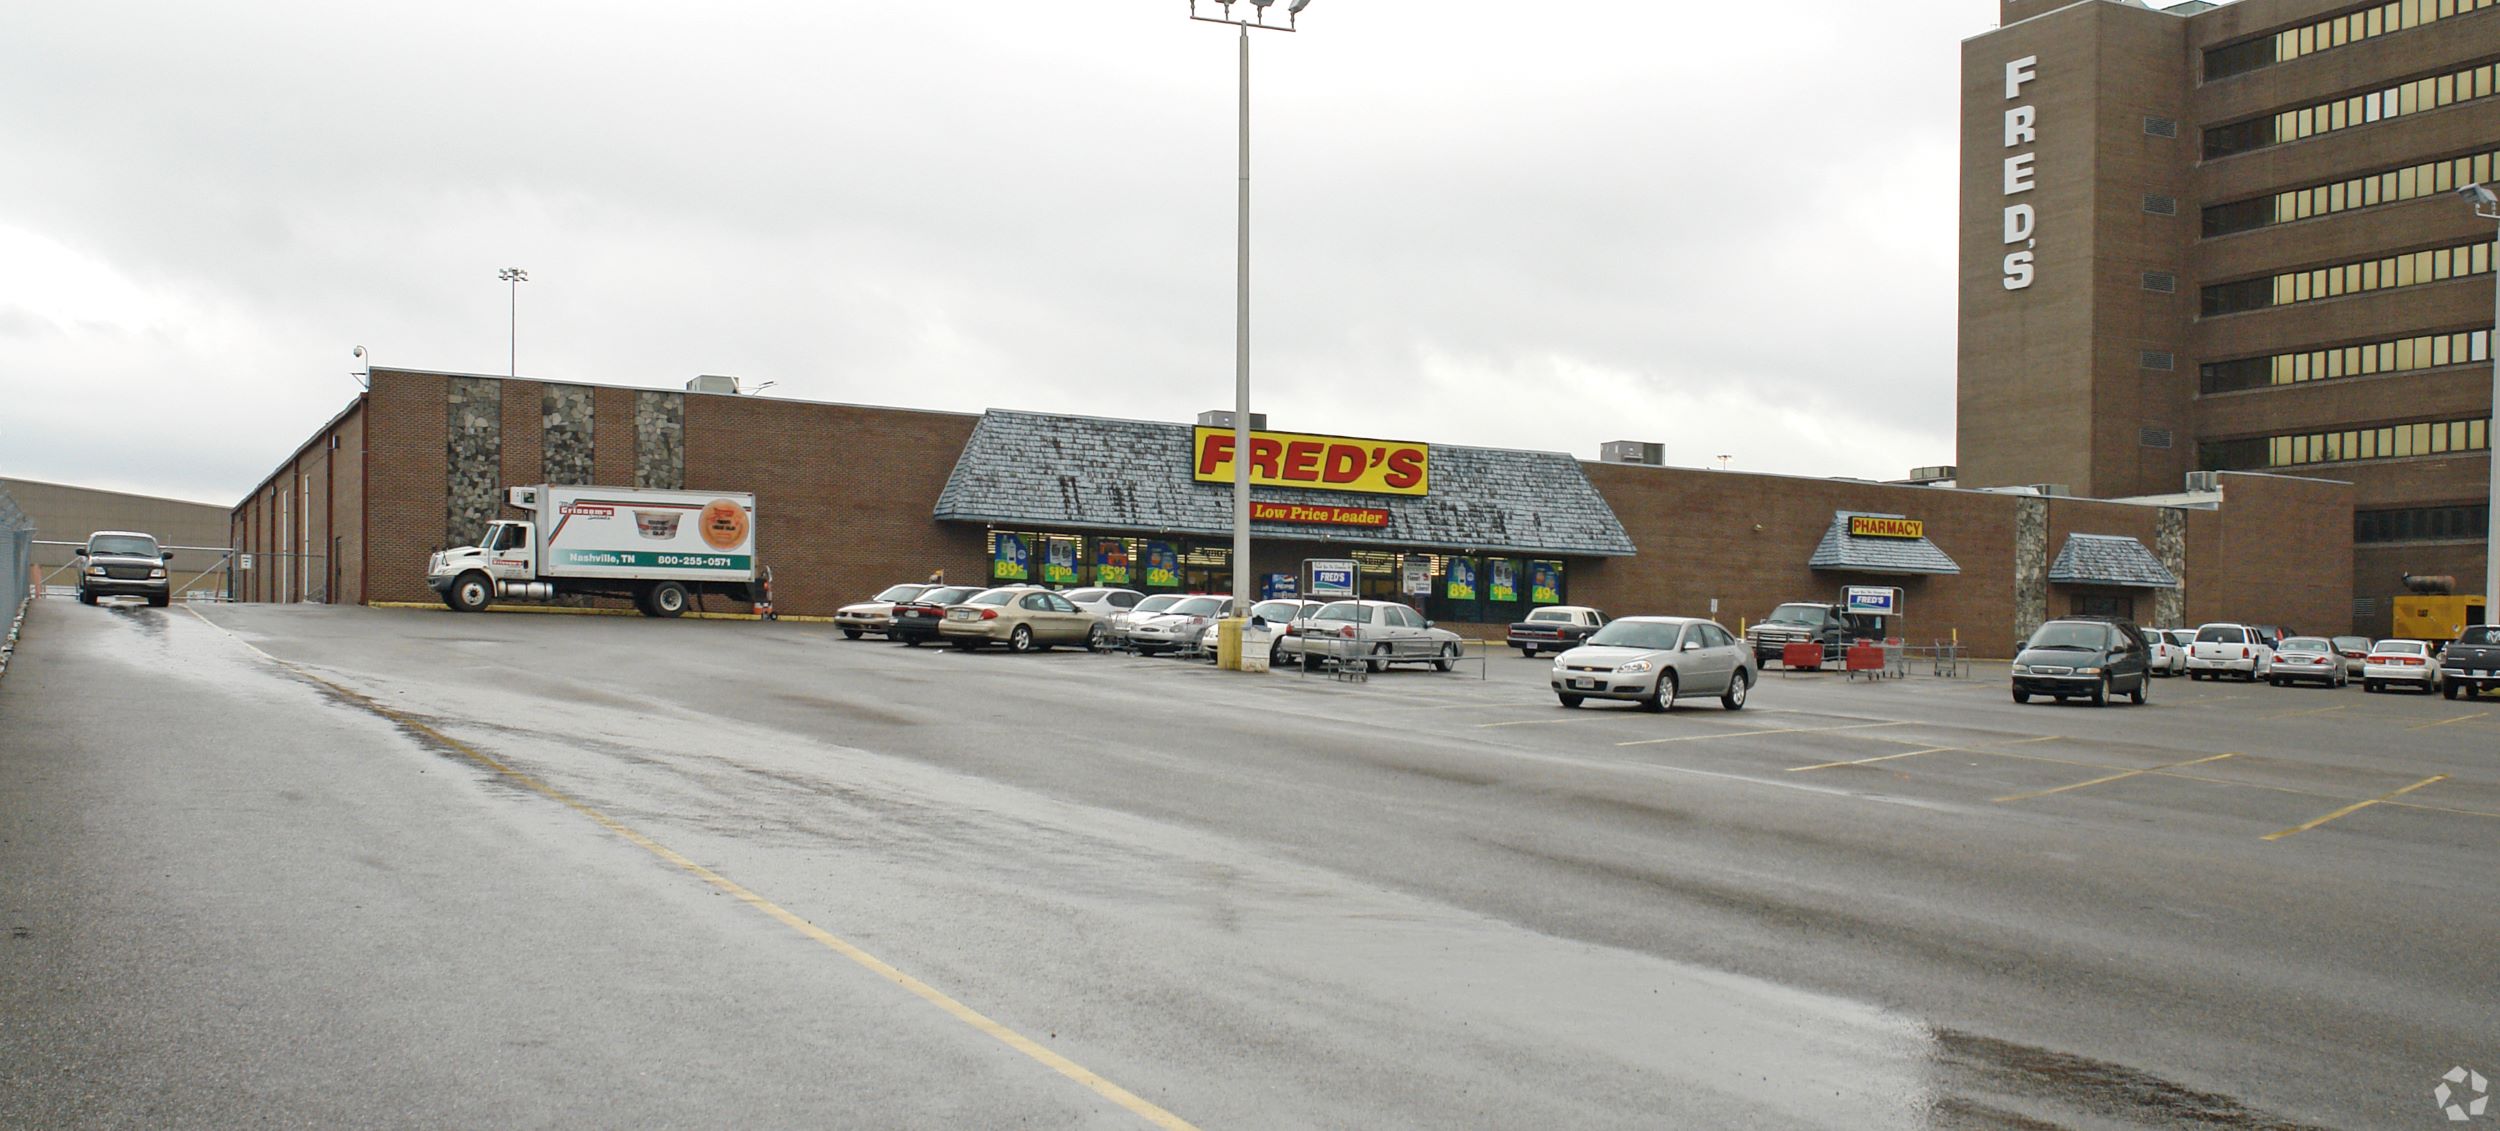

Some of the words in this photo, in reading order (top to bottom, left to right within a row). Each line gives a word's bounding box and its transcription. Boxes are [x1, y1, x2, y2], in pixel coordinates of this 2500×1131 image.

[2003, 55, 2036, 290] FRED'S
[1199, 435, 1424, 488] FRED'S
[1255, 504, 1287, 519] Low
[1290, 506, 1328, 521] Price
[1332, 508, 1383, 524] Leader
[1854, 519, 1920, 535] PHARMACY
[569, 552, 619, 564] Nashville,
[621, 554, 635, 563] TN
[658, 556, 731, 566] 800-255-0571
[1320, 572, 1345, 582] FRED'S
[1857, 595, 1884, 604] FRED'S
